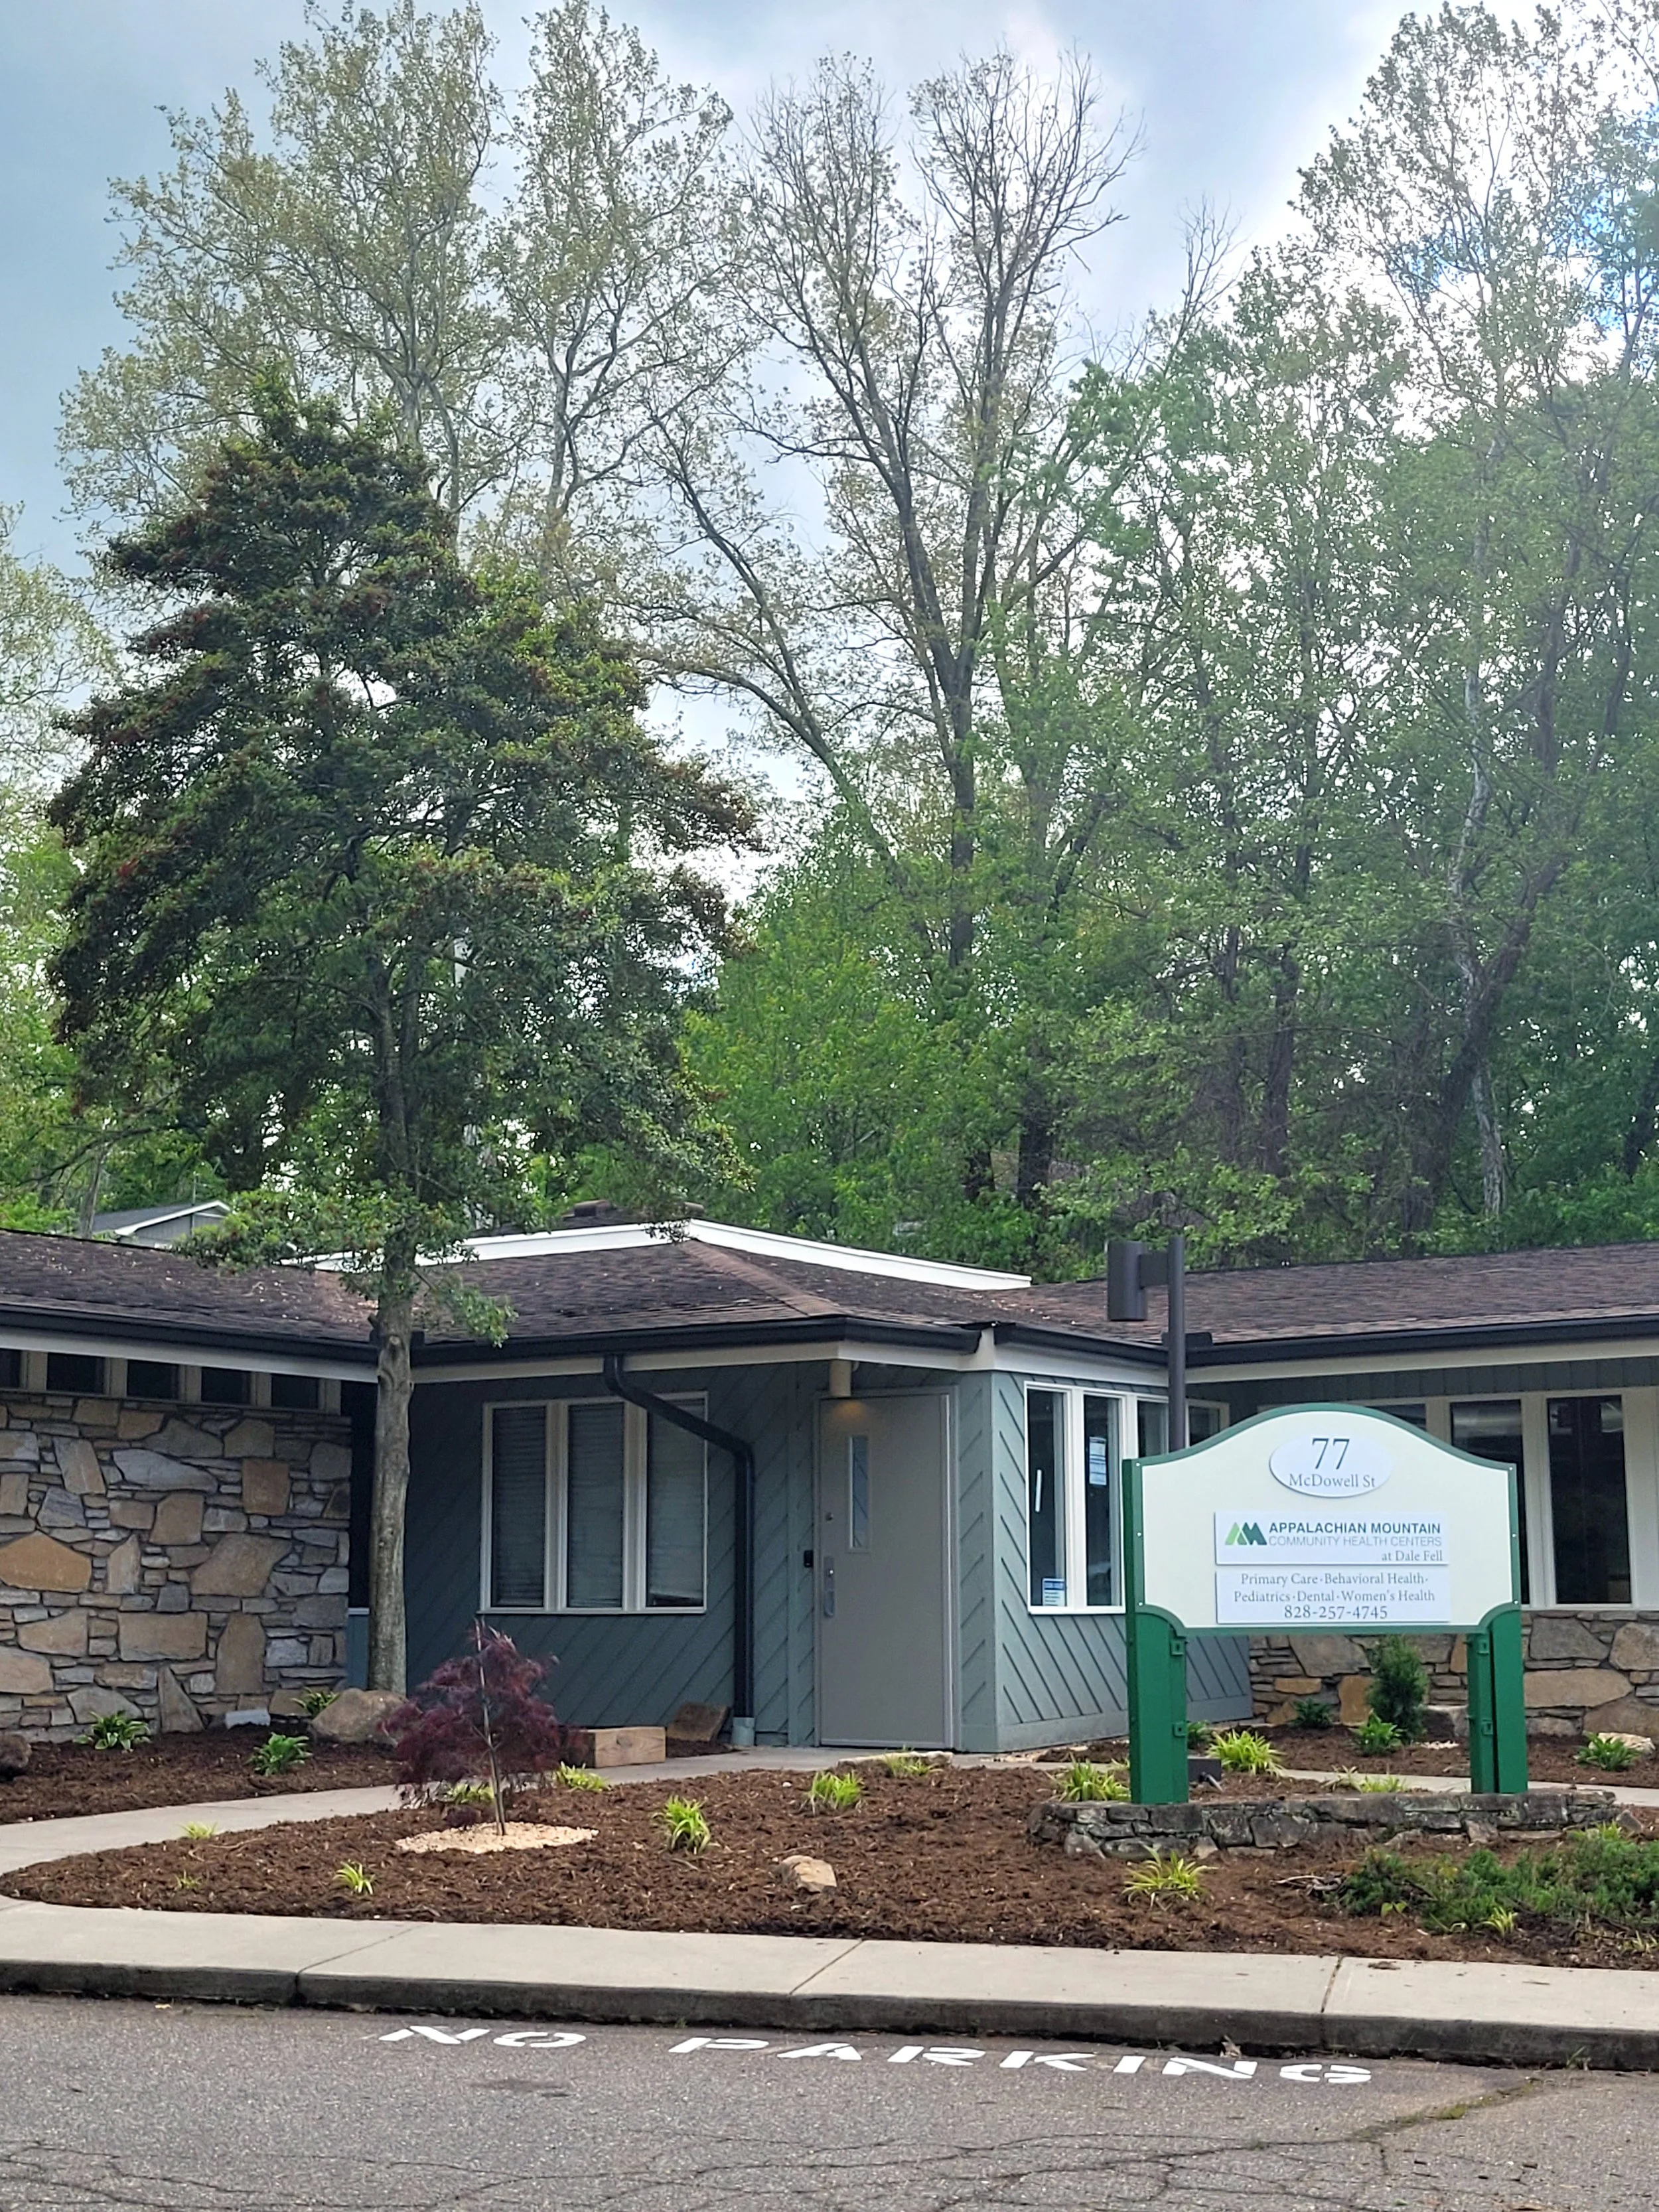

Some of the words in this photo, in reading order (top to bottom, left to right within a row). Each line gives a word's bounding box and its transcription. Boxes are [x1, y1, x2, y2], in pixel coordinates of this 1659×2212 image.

[1312, 1438, 1350, 1469] 77
[1289, 1473, 1358, 1487] McDowell
[1362, 1474, 1375, 1487] St
[1269, 1522, 1366, 1534] APPALACHIAN
[1371, 1522, 1441, 1534] MOUNTAIN
[1269, 1536, 1340, 1546] COMMUNITY
[1343, 1536, 1387, 1546] HEALTH
[1390, 1536, 1442, 1546] CENTERS
[1382, 1552, 1392, 1561] at
[1396, 1550, 1420, 1561] Dale
[1423, 1550, 1443, 1562] Fell
[1241, 1573, 1287, 1587] Primary
[1325, 1572, 1384, 1584] Behavioral
[1234, 1591, 1291, 1602] Pediatrics
[1341, 1589, 1395, 1601] Women's
[1398, 1589, 1435, 1601] Health
[1284, 1604, 1388, 1619] 828-257-4745
[379, 2026, 587, 2047] NO
[668, 2037, 1372, 2083] PARKING
